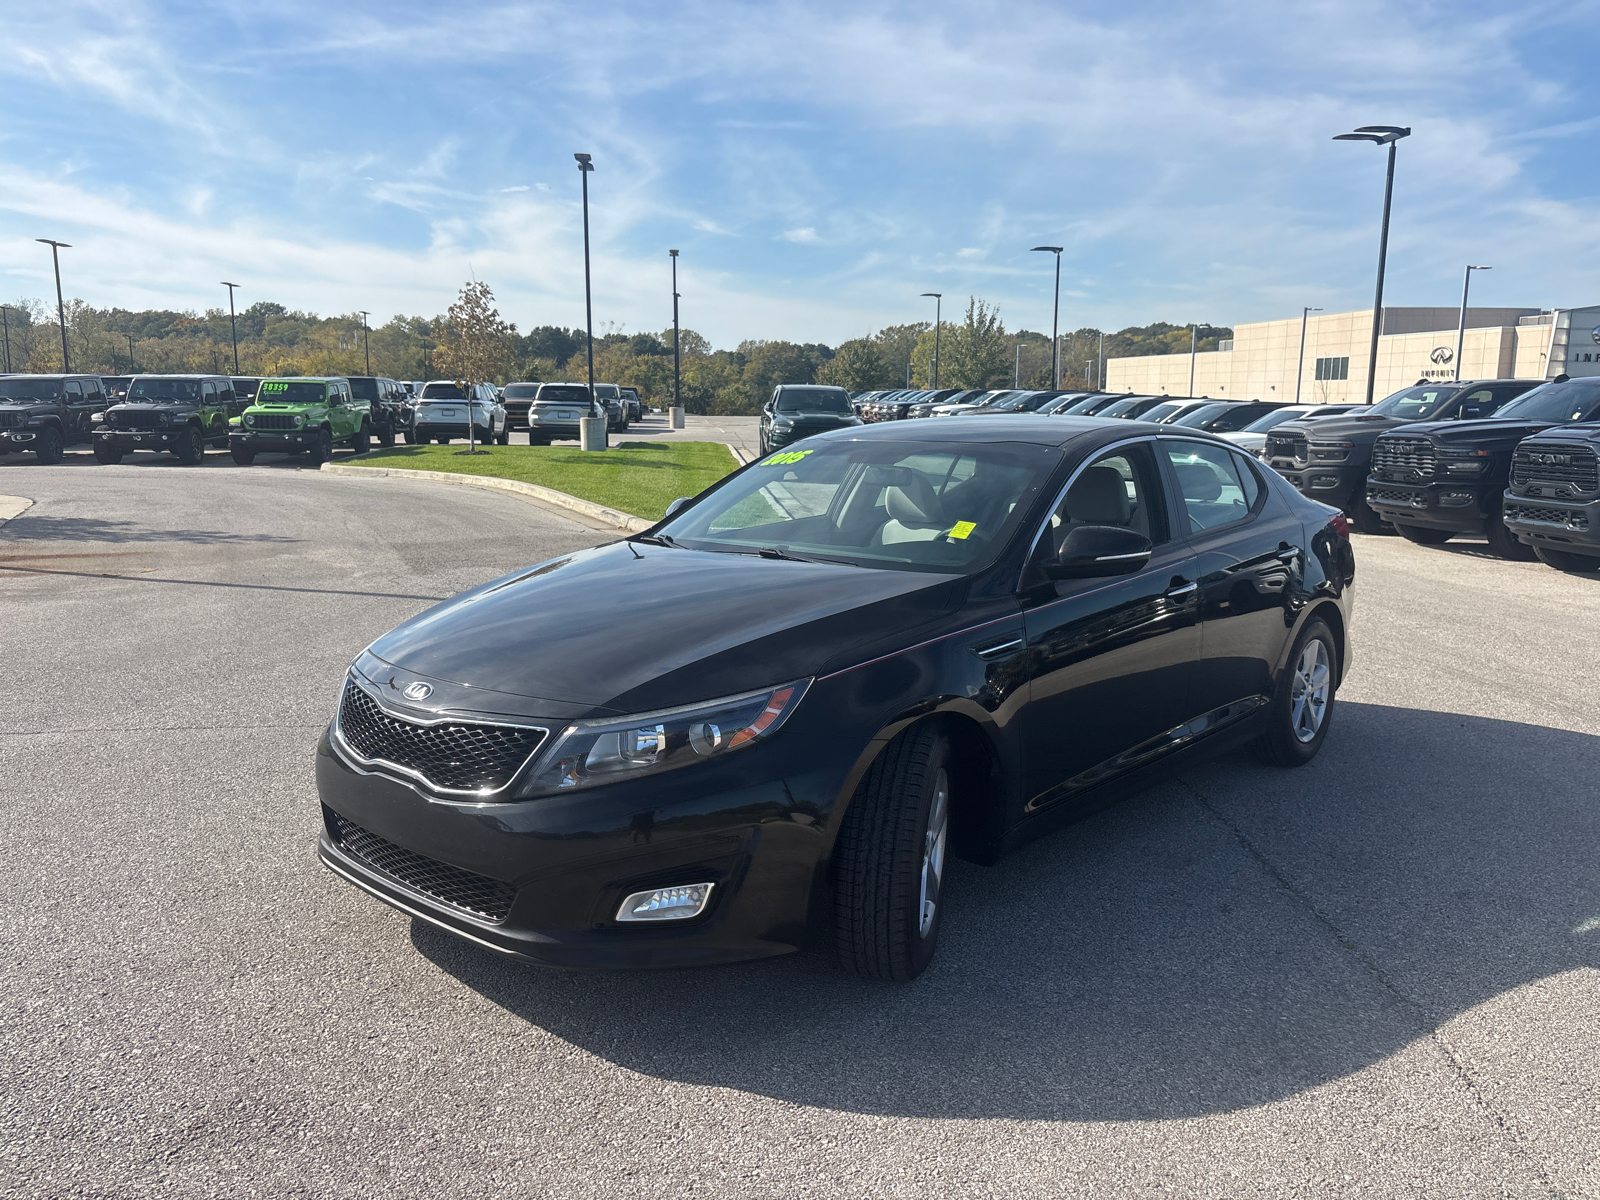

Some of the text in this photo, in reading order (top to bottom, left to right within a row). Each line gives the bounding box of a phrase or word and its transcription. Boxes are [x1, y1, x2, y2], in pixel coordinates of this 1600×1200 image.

[263, 383, 289, 391] 38359
[760, 450, 814, 466] 2015
[1529, 453, 1571, 463] RAM
[404, 684, 428, 698] KIA
